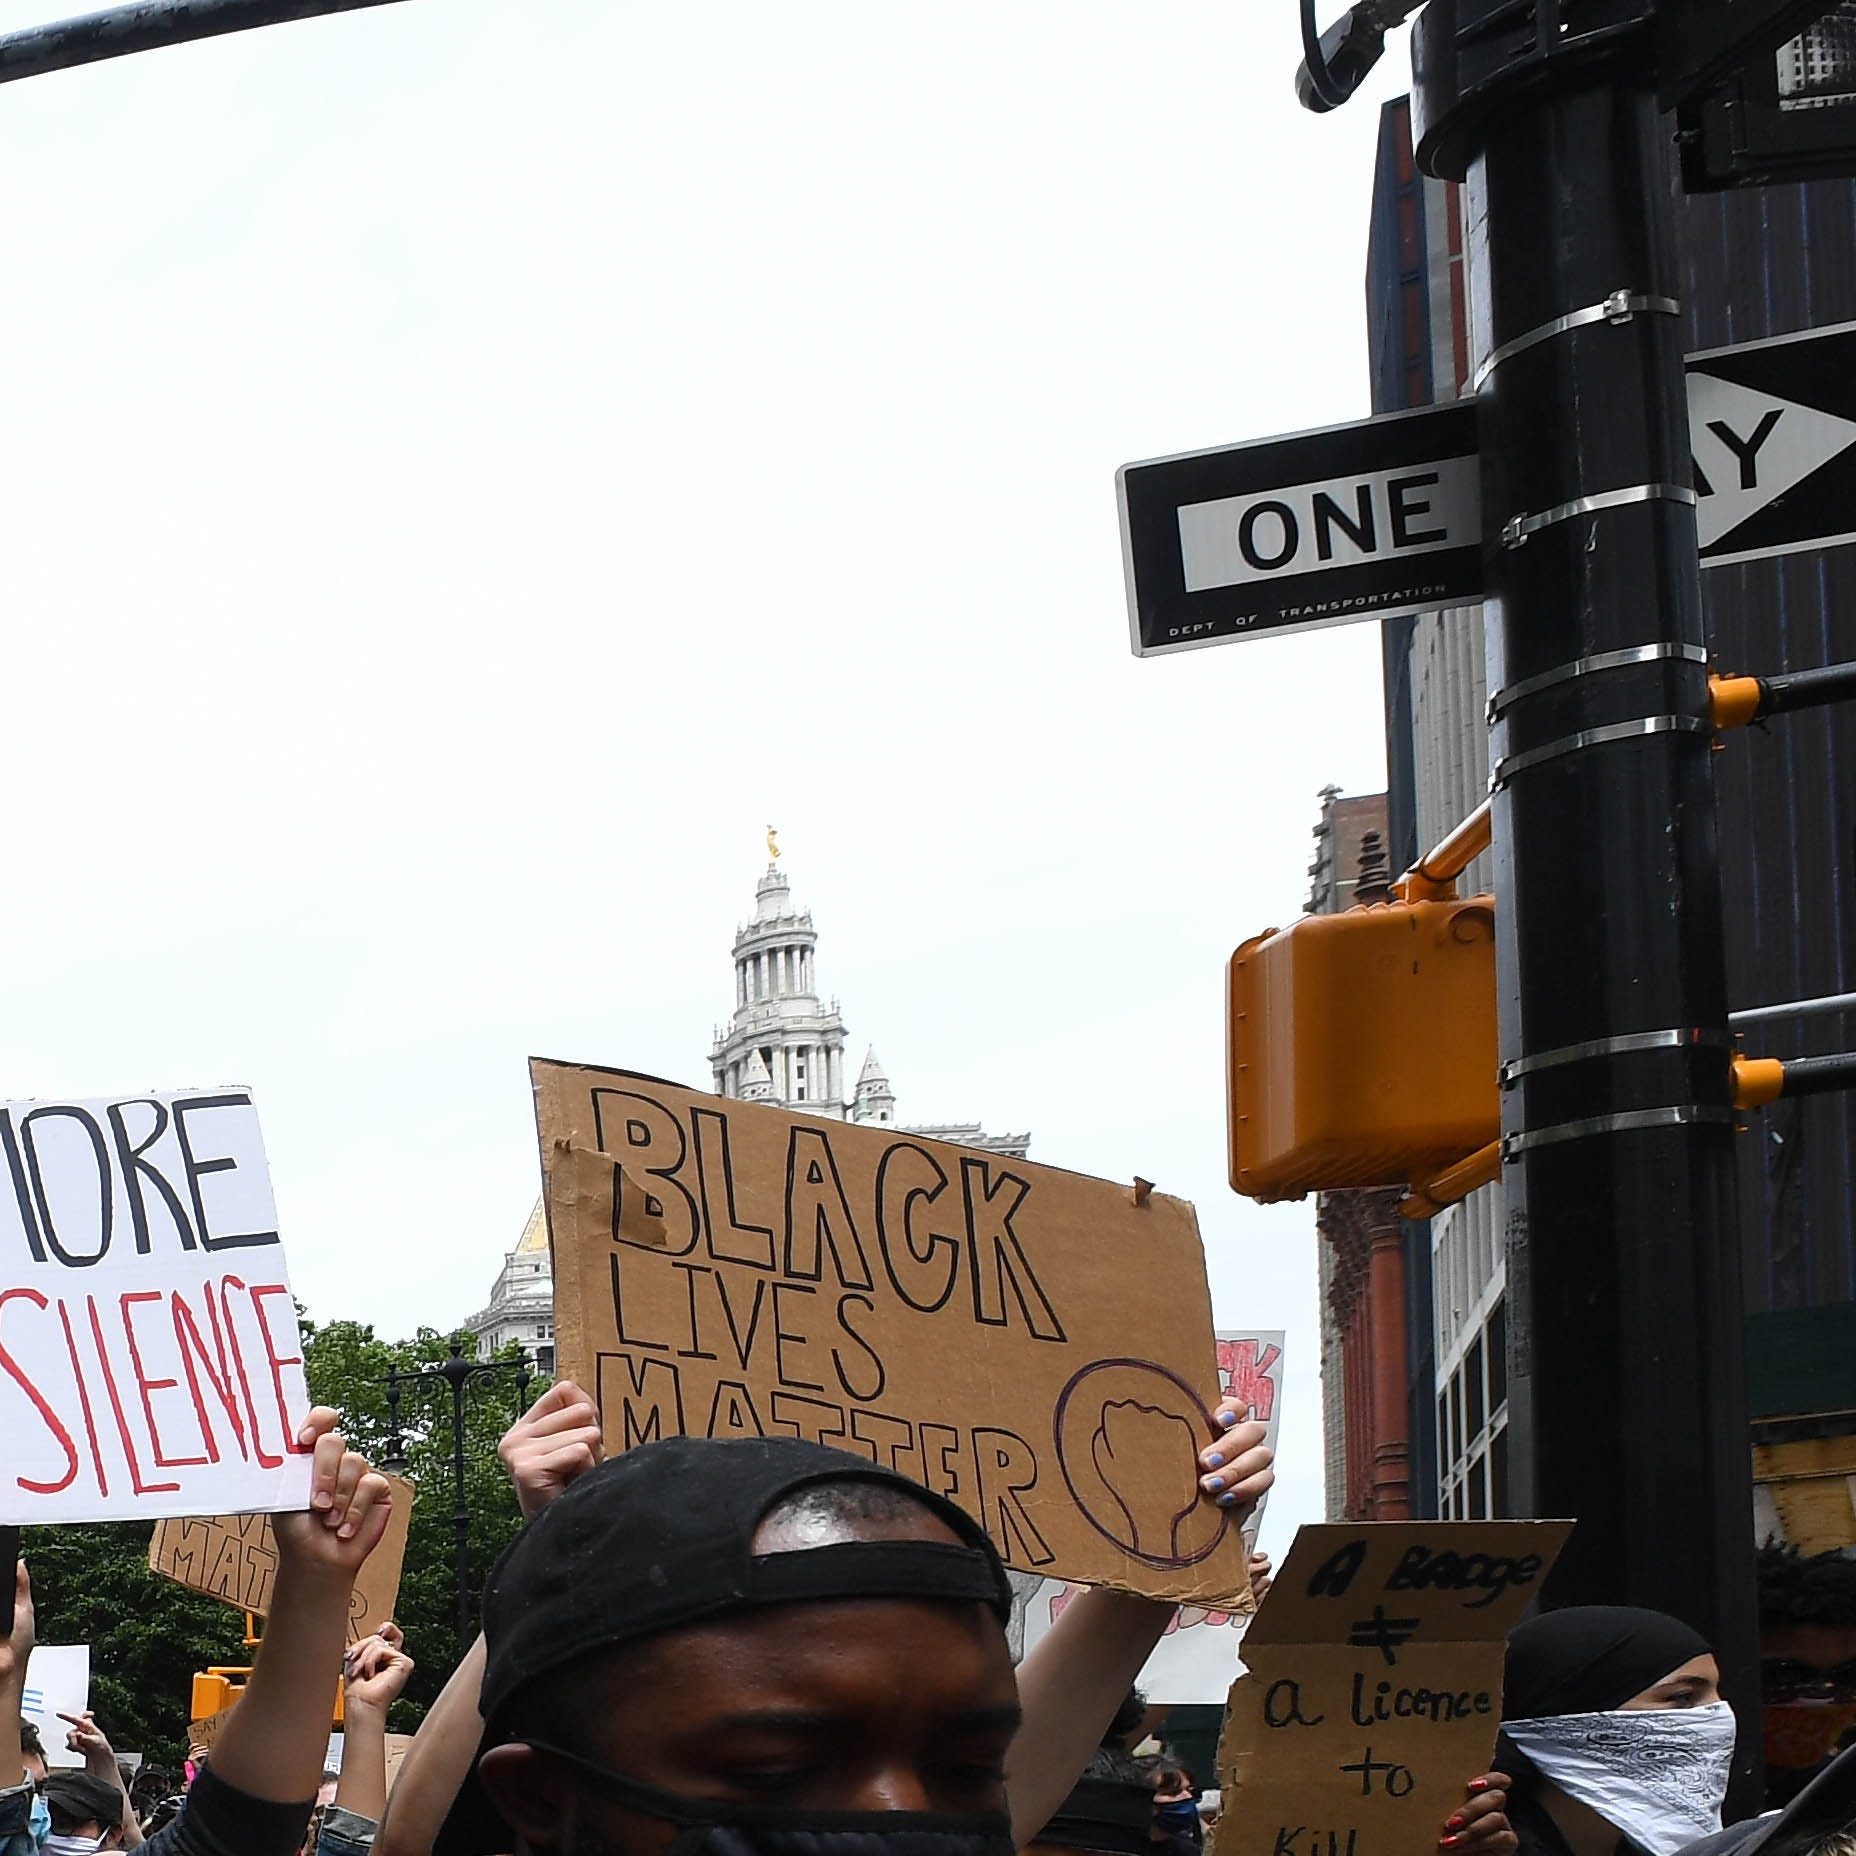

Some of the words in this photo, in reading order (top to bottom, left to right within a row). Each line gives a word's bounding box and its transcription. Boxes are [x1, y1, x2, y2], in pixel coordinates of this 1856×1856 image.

[1237, 472, 1448, 572] ONE
[1169, 621, 1215, 637] DEPT
[1280, 584, 1446, 619] TRANSPORTATION
[592, 1086, 1067, 1343] BLACK
[611, 1251, 885, 1401] LIVES
[1307, 1540, 1367, 1597] A
[1339, 1748, 1416, 1797] to
